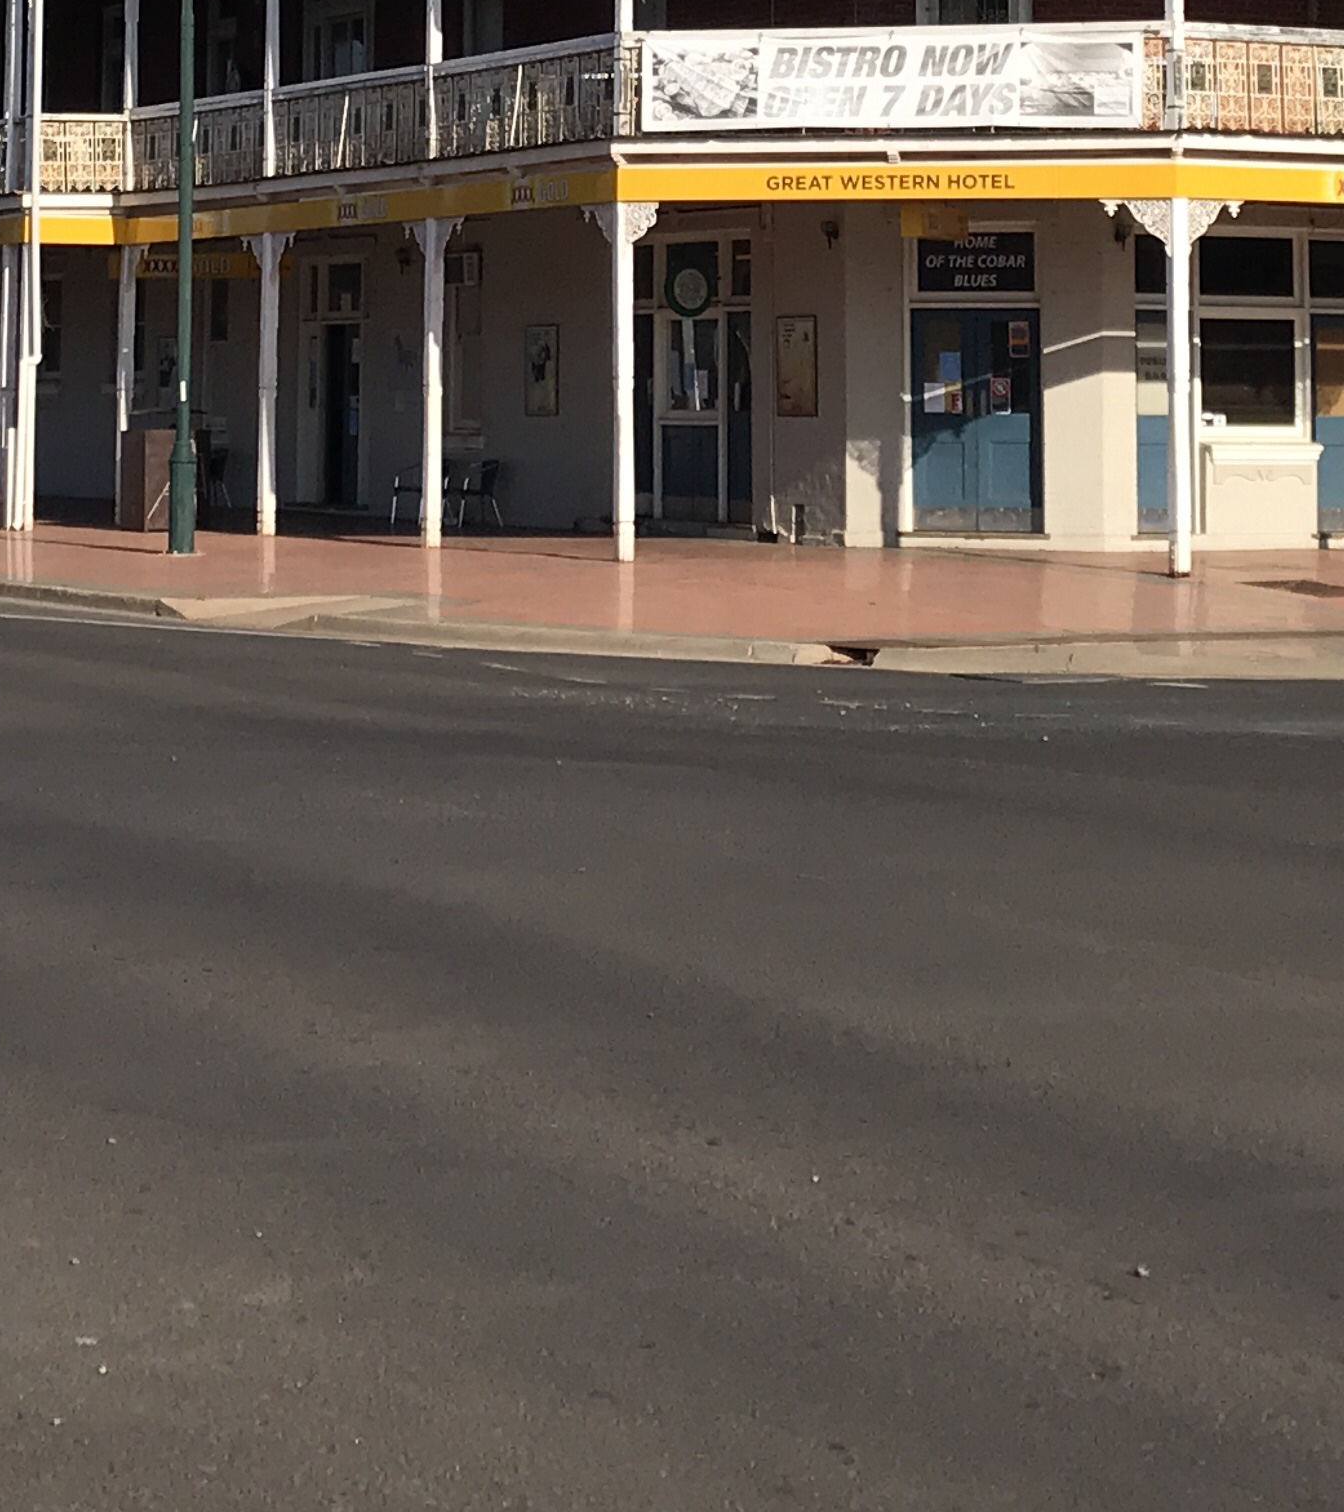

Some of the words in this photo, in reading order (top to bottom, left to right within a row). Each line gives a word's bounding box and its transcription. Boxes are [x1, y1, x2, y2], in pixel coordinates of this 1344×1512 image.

[769, 44, 907, 80] BISTRO
[918, 42, 1014, 77] NOW
[879, 85, 906, 118] 7
[914, 83, 1017, 117] DAYS
[766, 175, 833, 191] GREAT
[840, 175, 940, 191] WESTERN
[948, 174, 1015, 190] HOTEL
[953, 236, 998, 249] HOME
[925, 254, 946, 268] OF
[948, 254, 976, 268] THE
[977, 254, 1026, 268] COBAR
[953, 274, 998, 287] BLUES
